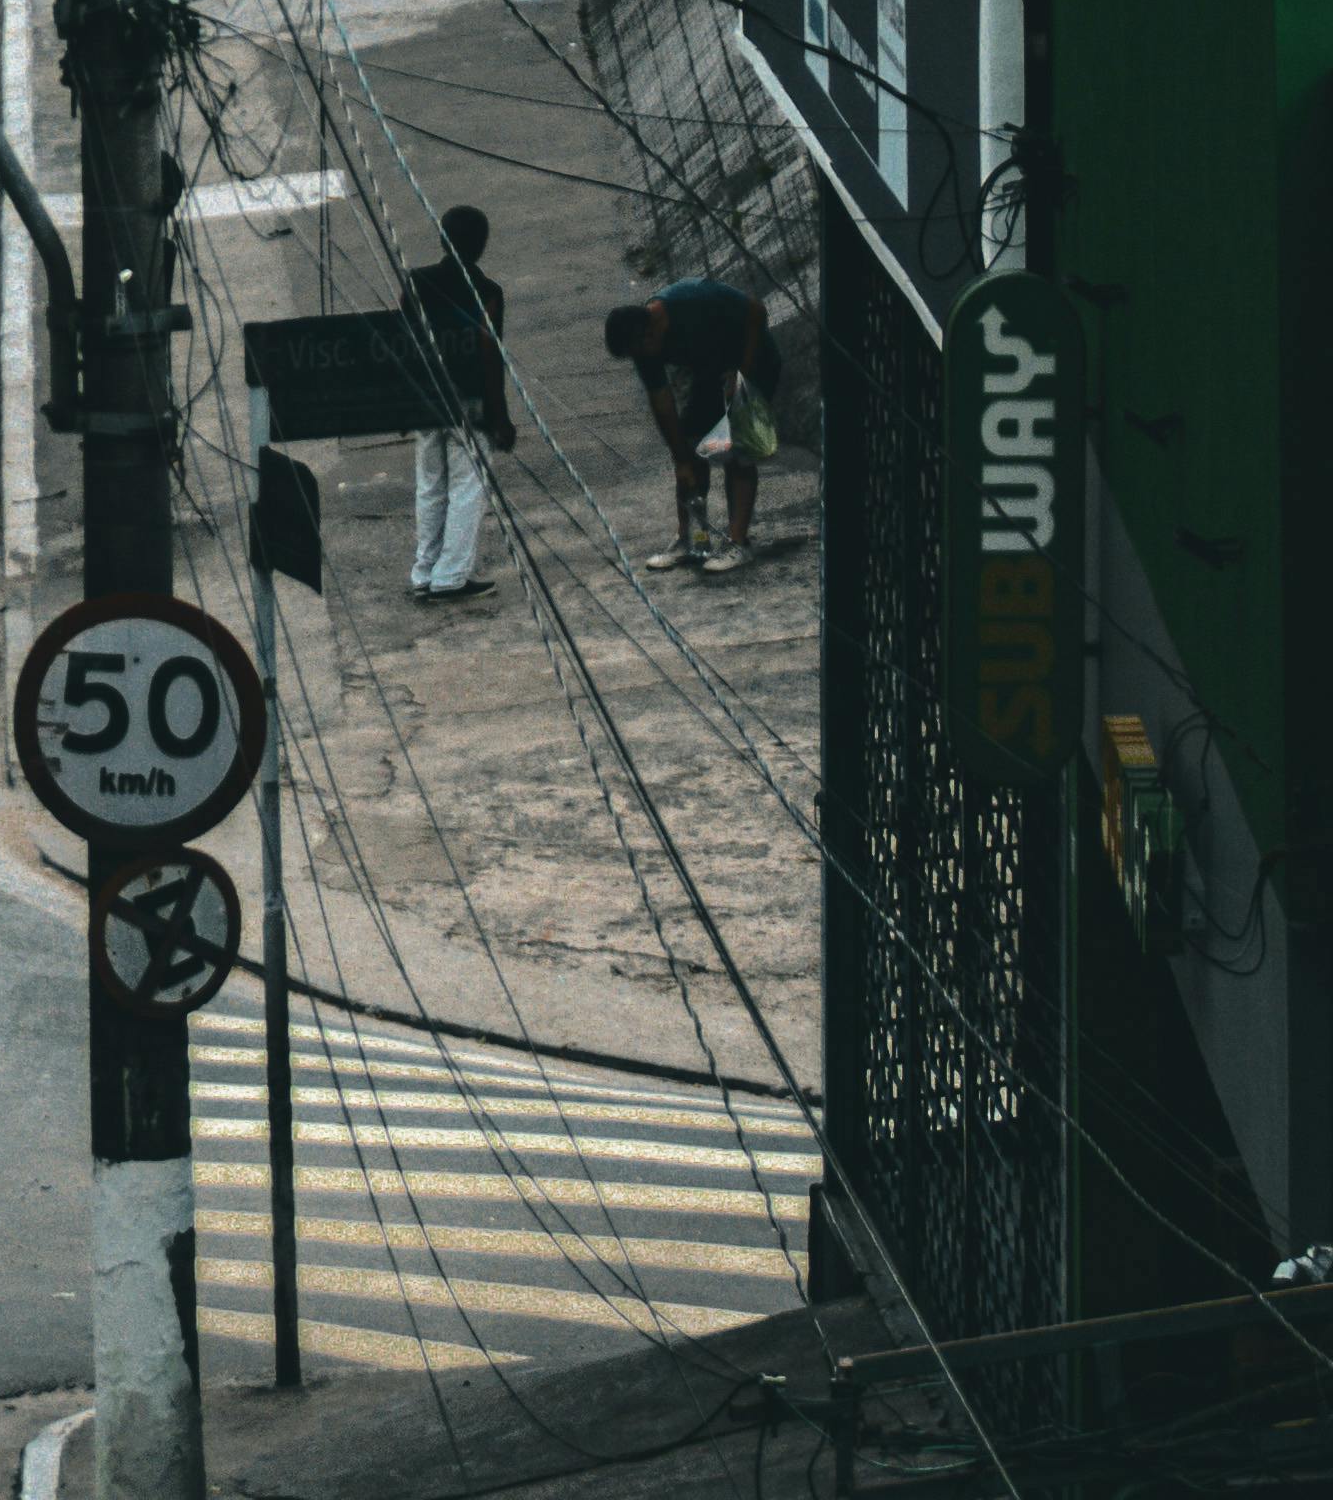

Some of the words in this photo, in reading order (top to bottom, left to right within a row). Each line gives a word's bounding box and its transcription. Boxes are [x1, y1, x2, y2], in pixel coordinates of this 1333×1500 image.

[978, 303, 1057, 758] SUBWAY
[61, 652, 221, 758] 50
[99, 766, 176, 797] km/h
